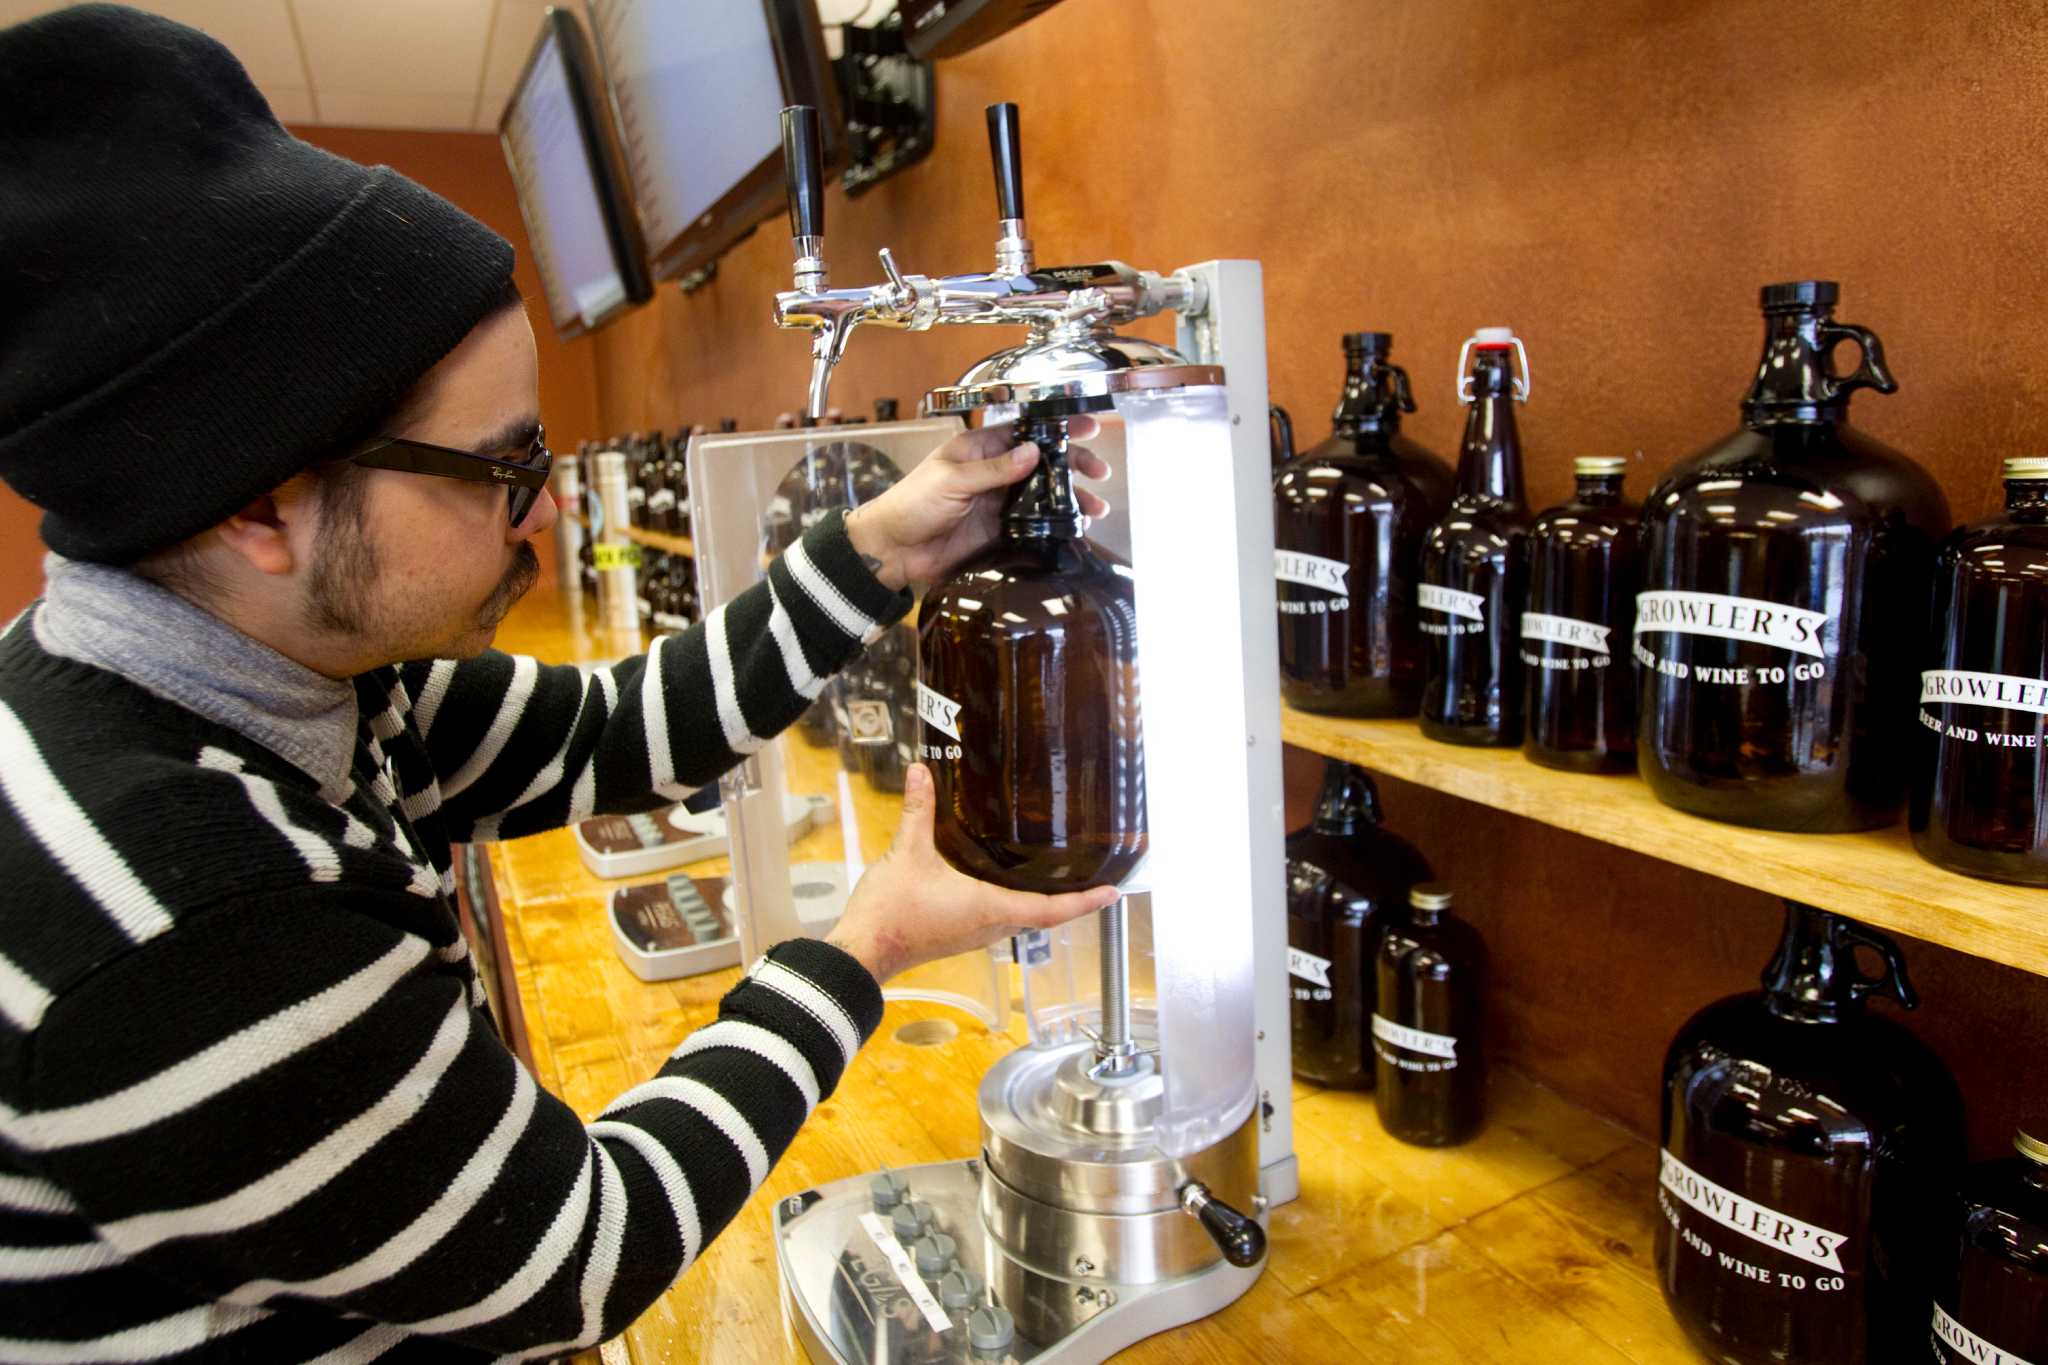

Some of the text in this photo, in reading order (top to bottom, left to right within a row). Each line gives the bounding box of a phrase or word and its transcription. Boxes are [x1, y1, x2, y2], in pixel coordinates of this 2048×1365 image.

[1274, 556, 1338, 585] LER'S
[1308, 600, 1327, 615] TO
[1329, 598, 1349, 612] GO
[1641, 599, 1812, 643] GROWLER'S
[1656, 658, 1689, 679] AND
[1694, 665, 1749, 685] WINE
[1755, 667, 1785, 684] TO
[1795, 662, 1824, 681] GO
[1945, 724, 1978, 742] AND
[1985, 732, 2037, 747] WINE
[945, 745, 963, 760] GO
[1664, 1159, 1833, 1258] GROWLER'S
[1681, 1227, 1713, 1257] AND
[1718, 1251, 1771, 1284] WINE
[1778, 1273, 1806, 1290] TO
[1815, 1277, 1845, 1291] GO
